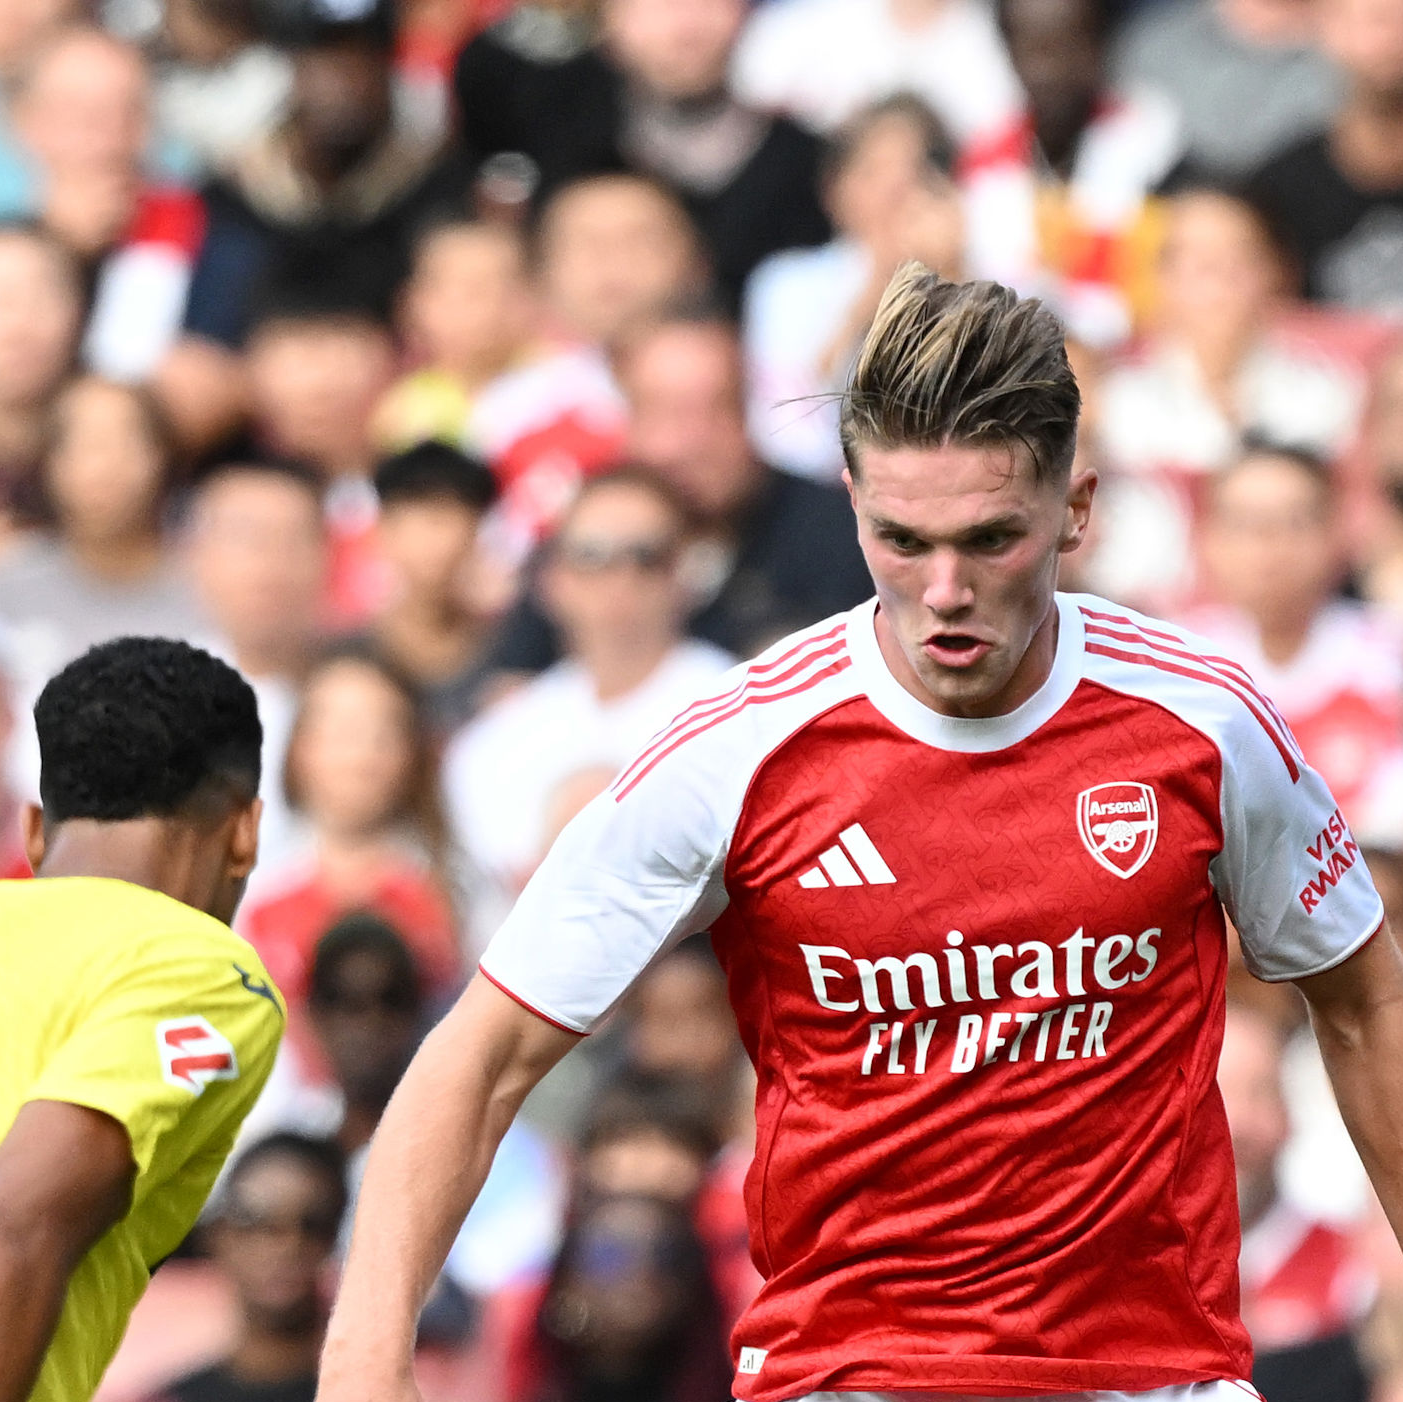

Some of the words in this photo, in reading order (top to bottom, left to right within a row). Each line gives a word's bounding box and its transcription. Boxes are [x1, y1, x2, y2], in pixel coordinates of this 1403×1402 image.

[1089, 796, 1147, 816] Arsenal
[798, 926, 1162, 1013] Emirates
[860, 1018, 938, 1076] FLY
[949, 1001, 1114, 1074] BETTER
